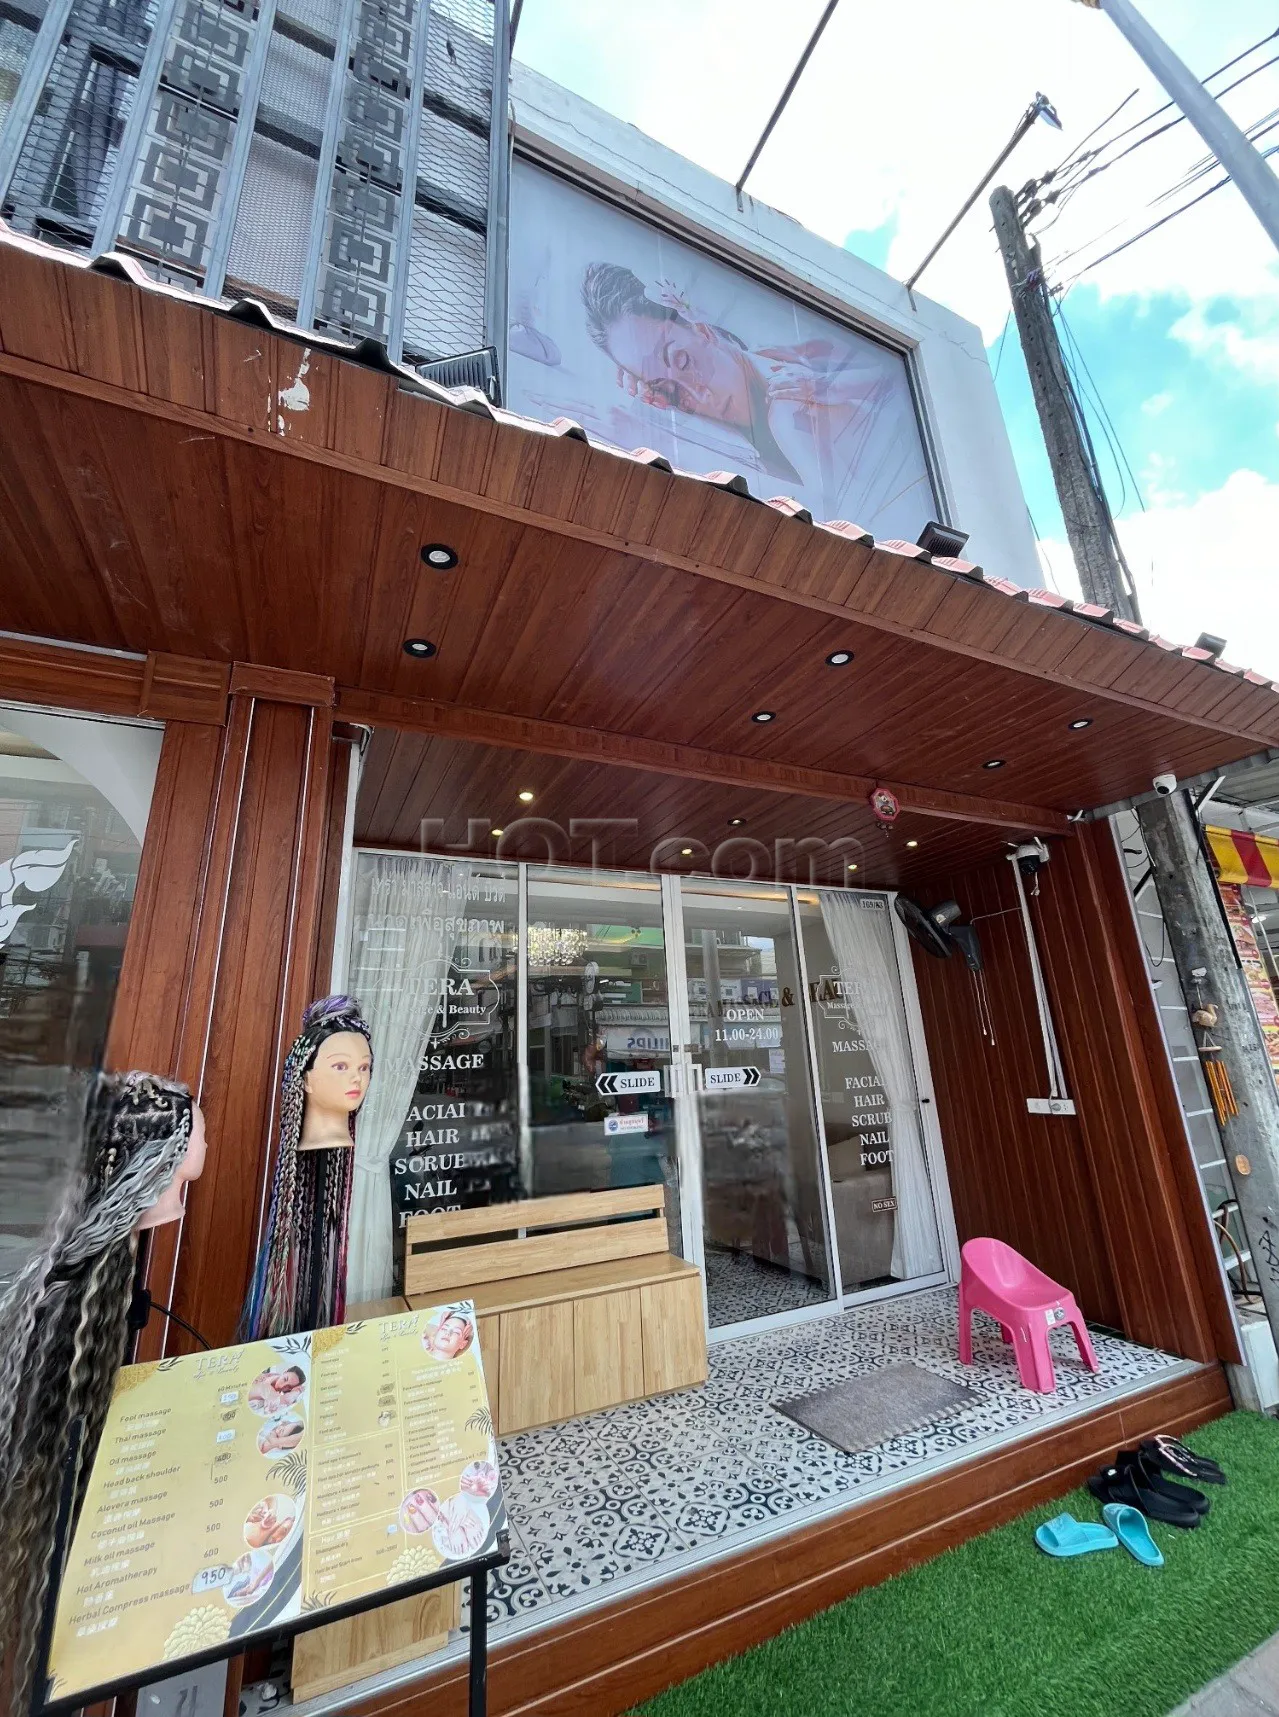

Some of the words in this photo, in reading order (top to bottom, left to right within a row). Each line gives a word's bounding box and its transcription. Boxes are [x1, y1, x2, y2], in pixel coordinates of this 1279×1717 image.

[404, 978, 475, 995] TERA
[449, 1004, 486, 1015] Beauty
[726, 1009, 764, 1022] OPEN
[715, 1028, 779, 1042] 11.00-24.00
[832, 1039, 883, 1053] MASSA
[385, 1054, 484, 1071] MASSAGE
[620, 1077, 655, 1089] SLIDE
[710, 1073, 741, 1084] SLIDE
[845, 1076, 885, 1089] FACIA
[854, 1094, 885, 1108] HAIR
[852, 1112, 893, 1127] SCRUB
[406, 1129, 460, 1148] HAIR
[860, 1131, 890, 1146] NAIL
[395, 1153, 465, 1175] SCRUB
[860, 1151, 893, 1166] FOOT
[404, 1180, 458, 1201] NAIL
[138, 1406, 172, 1421] massage
[131, 1427, 167, 1442] massage
[120, 1450, 157, 1464] massage
[103, 1475, 125, 1489] Head
[125, 1472, 145, 1485] back
[145, 1464, 181, 1482] shoulder
[214, 1475, 228, 1483] 500
[97, 1500, 130, 1514] Alovera
[131, 1490, 168, 1507] massage
[209, 1498, 224, 1508] 500
[91, 1524, 126, 1540] Coconut
[127, 1520, 138, 1531] oil
[139, 1510, 176, 1527] Massage
[206, 1522, 221, 1533] 500
[84, 1552, 102, 1566] Milk
[104, 1550, 116, 1560] oil
[116, 1541, 155, 1557] massage
[203, 1547, 219, 1558] 600
[76, 1582, 93, 1596] Hot
[94, 1566, 158, 1591] Aromatherapy
[201, 1567, 226, 1585] 950
[68, 1610, 101, 1626] Herbal
[102, 1594, 150, 1615] Compress
[150, 1582, 191, 1602] massage
